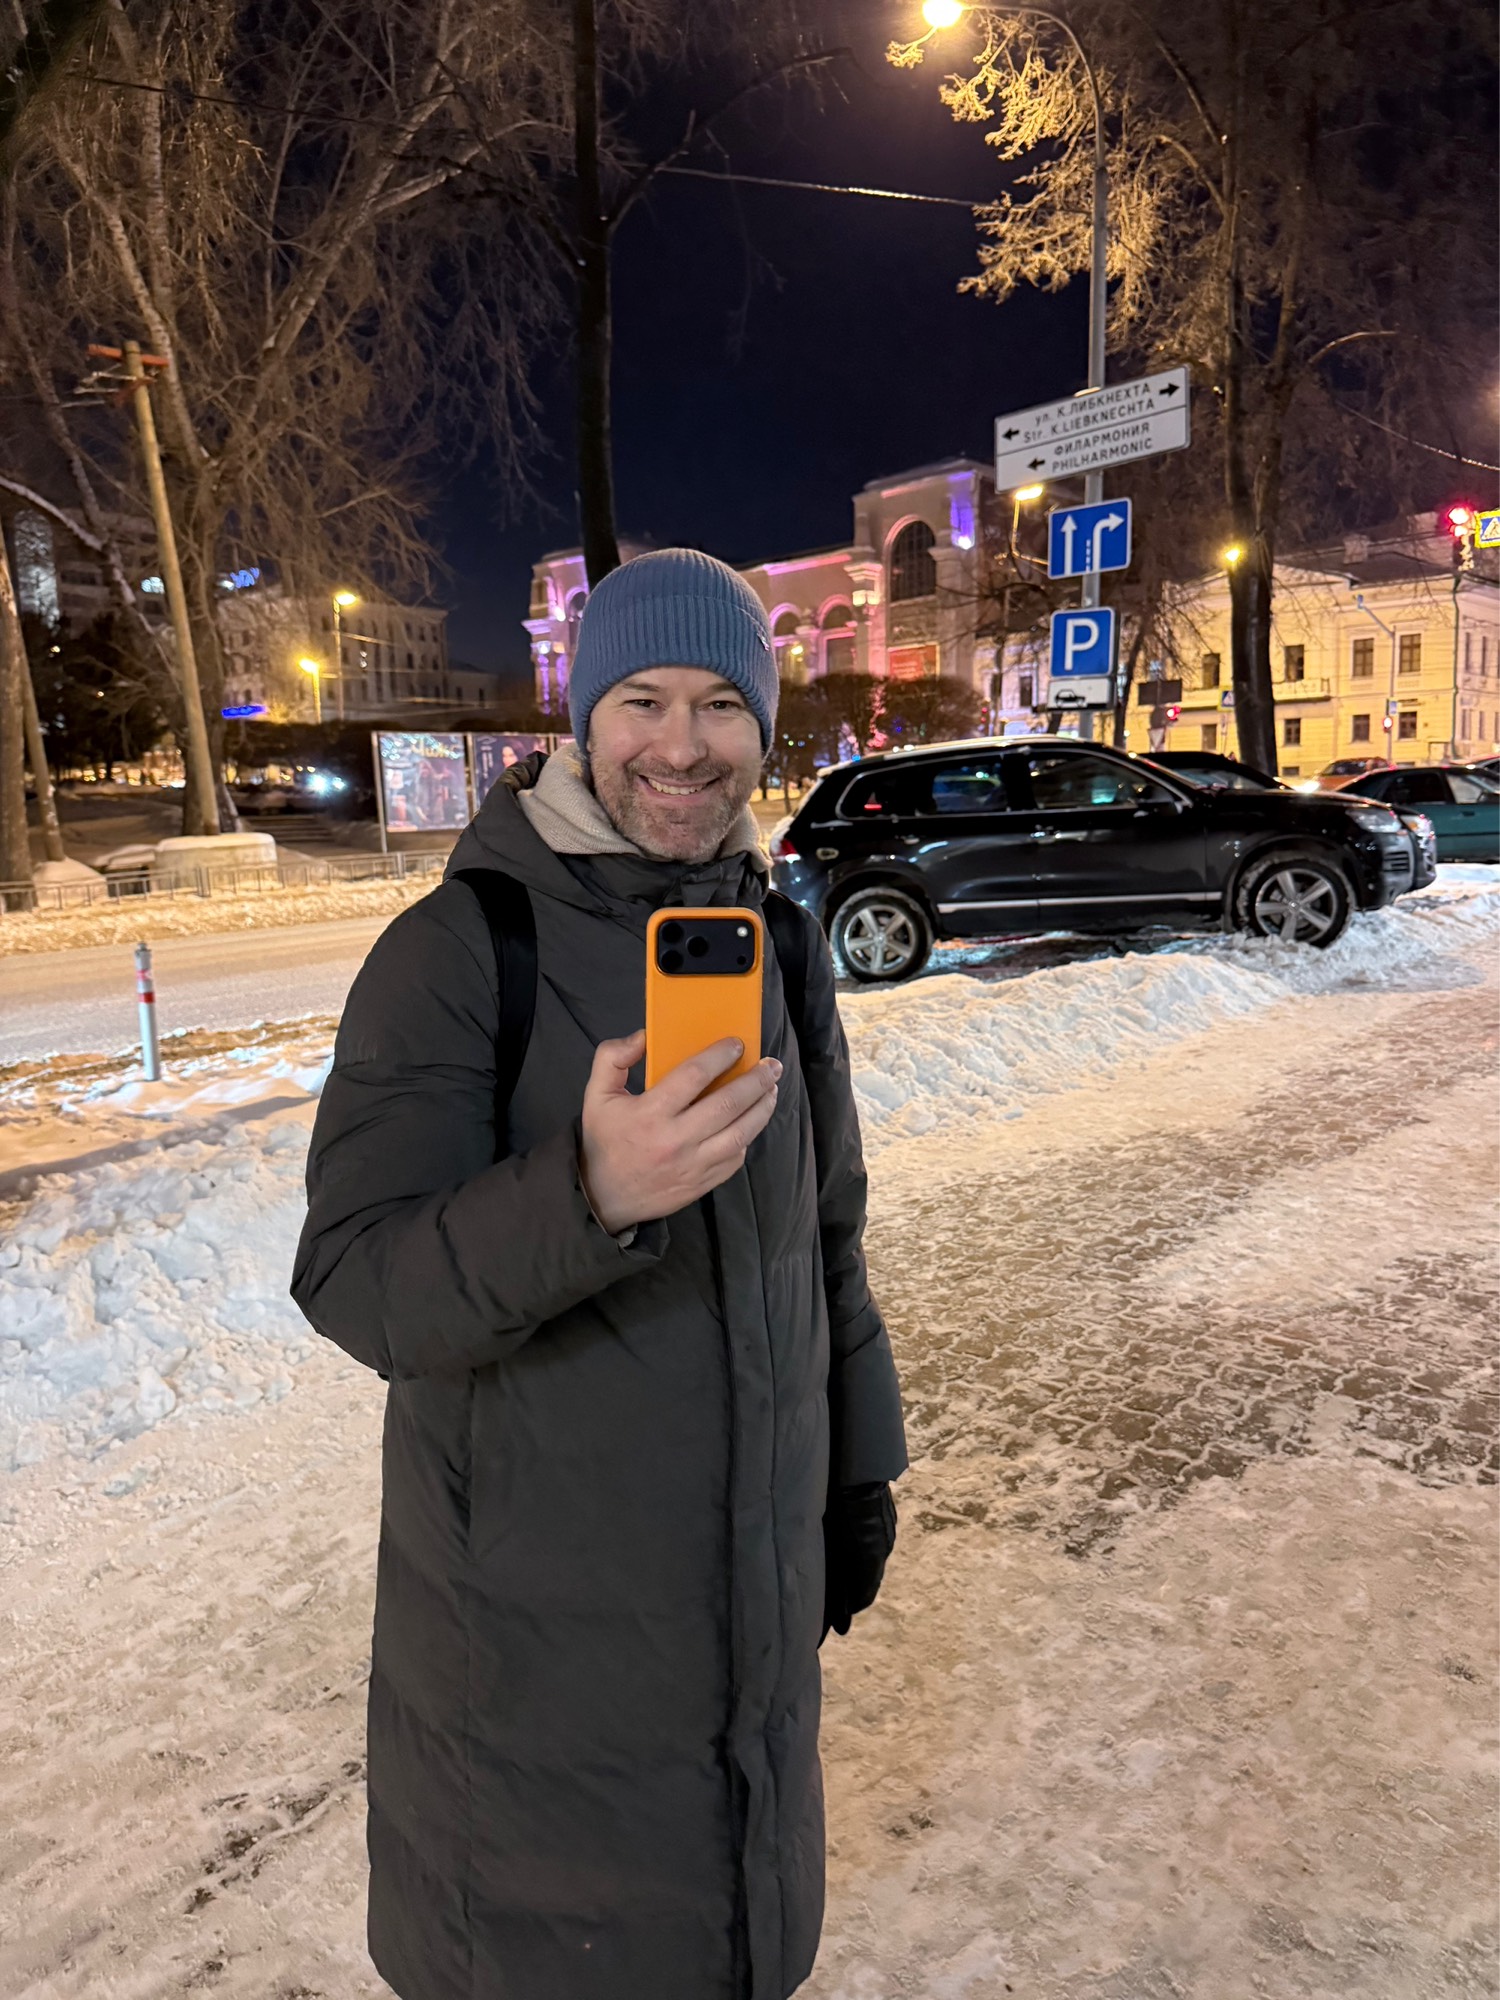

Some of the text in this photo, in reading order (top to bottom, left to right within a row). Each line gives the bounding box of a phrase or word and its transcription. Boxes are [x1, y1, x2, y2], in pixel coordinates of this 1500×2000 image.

[1024, 429, 1044, 443] Str.
[1035, 412, 1053, 427] ул.
[1052, 438, 1153, 472] PHILHARMONIC
[1054, 422, 1150, 456] ФИЛАРМОНИЯ
[1064, 618, 1099, 670] P
